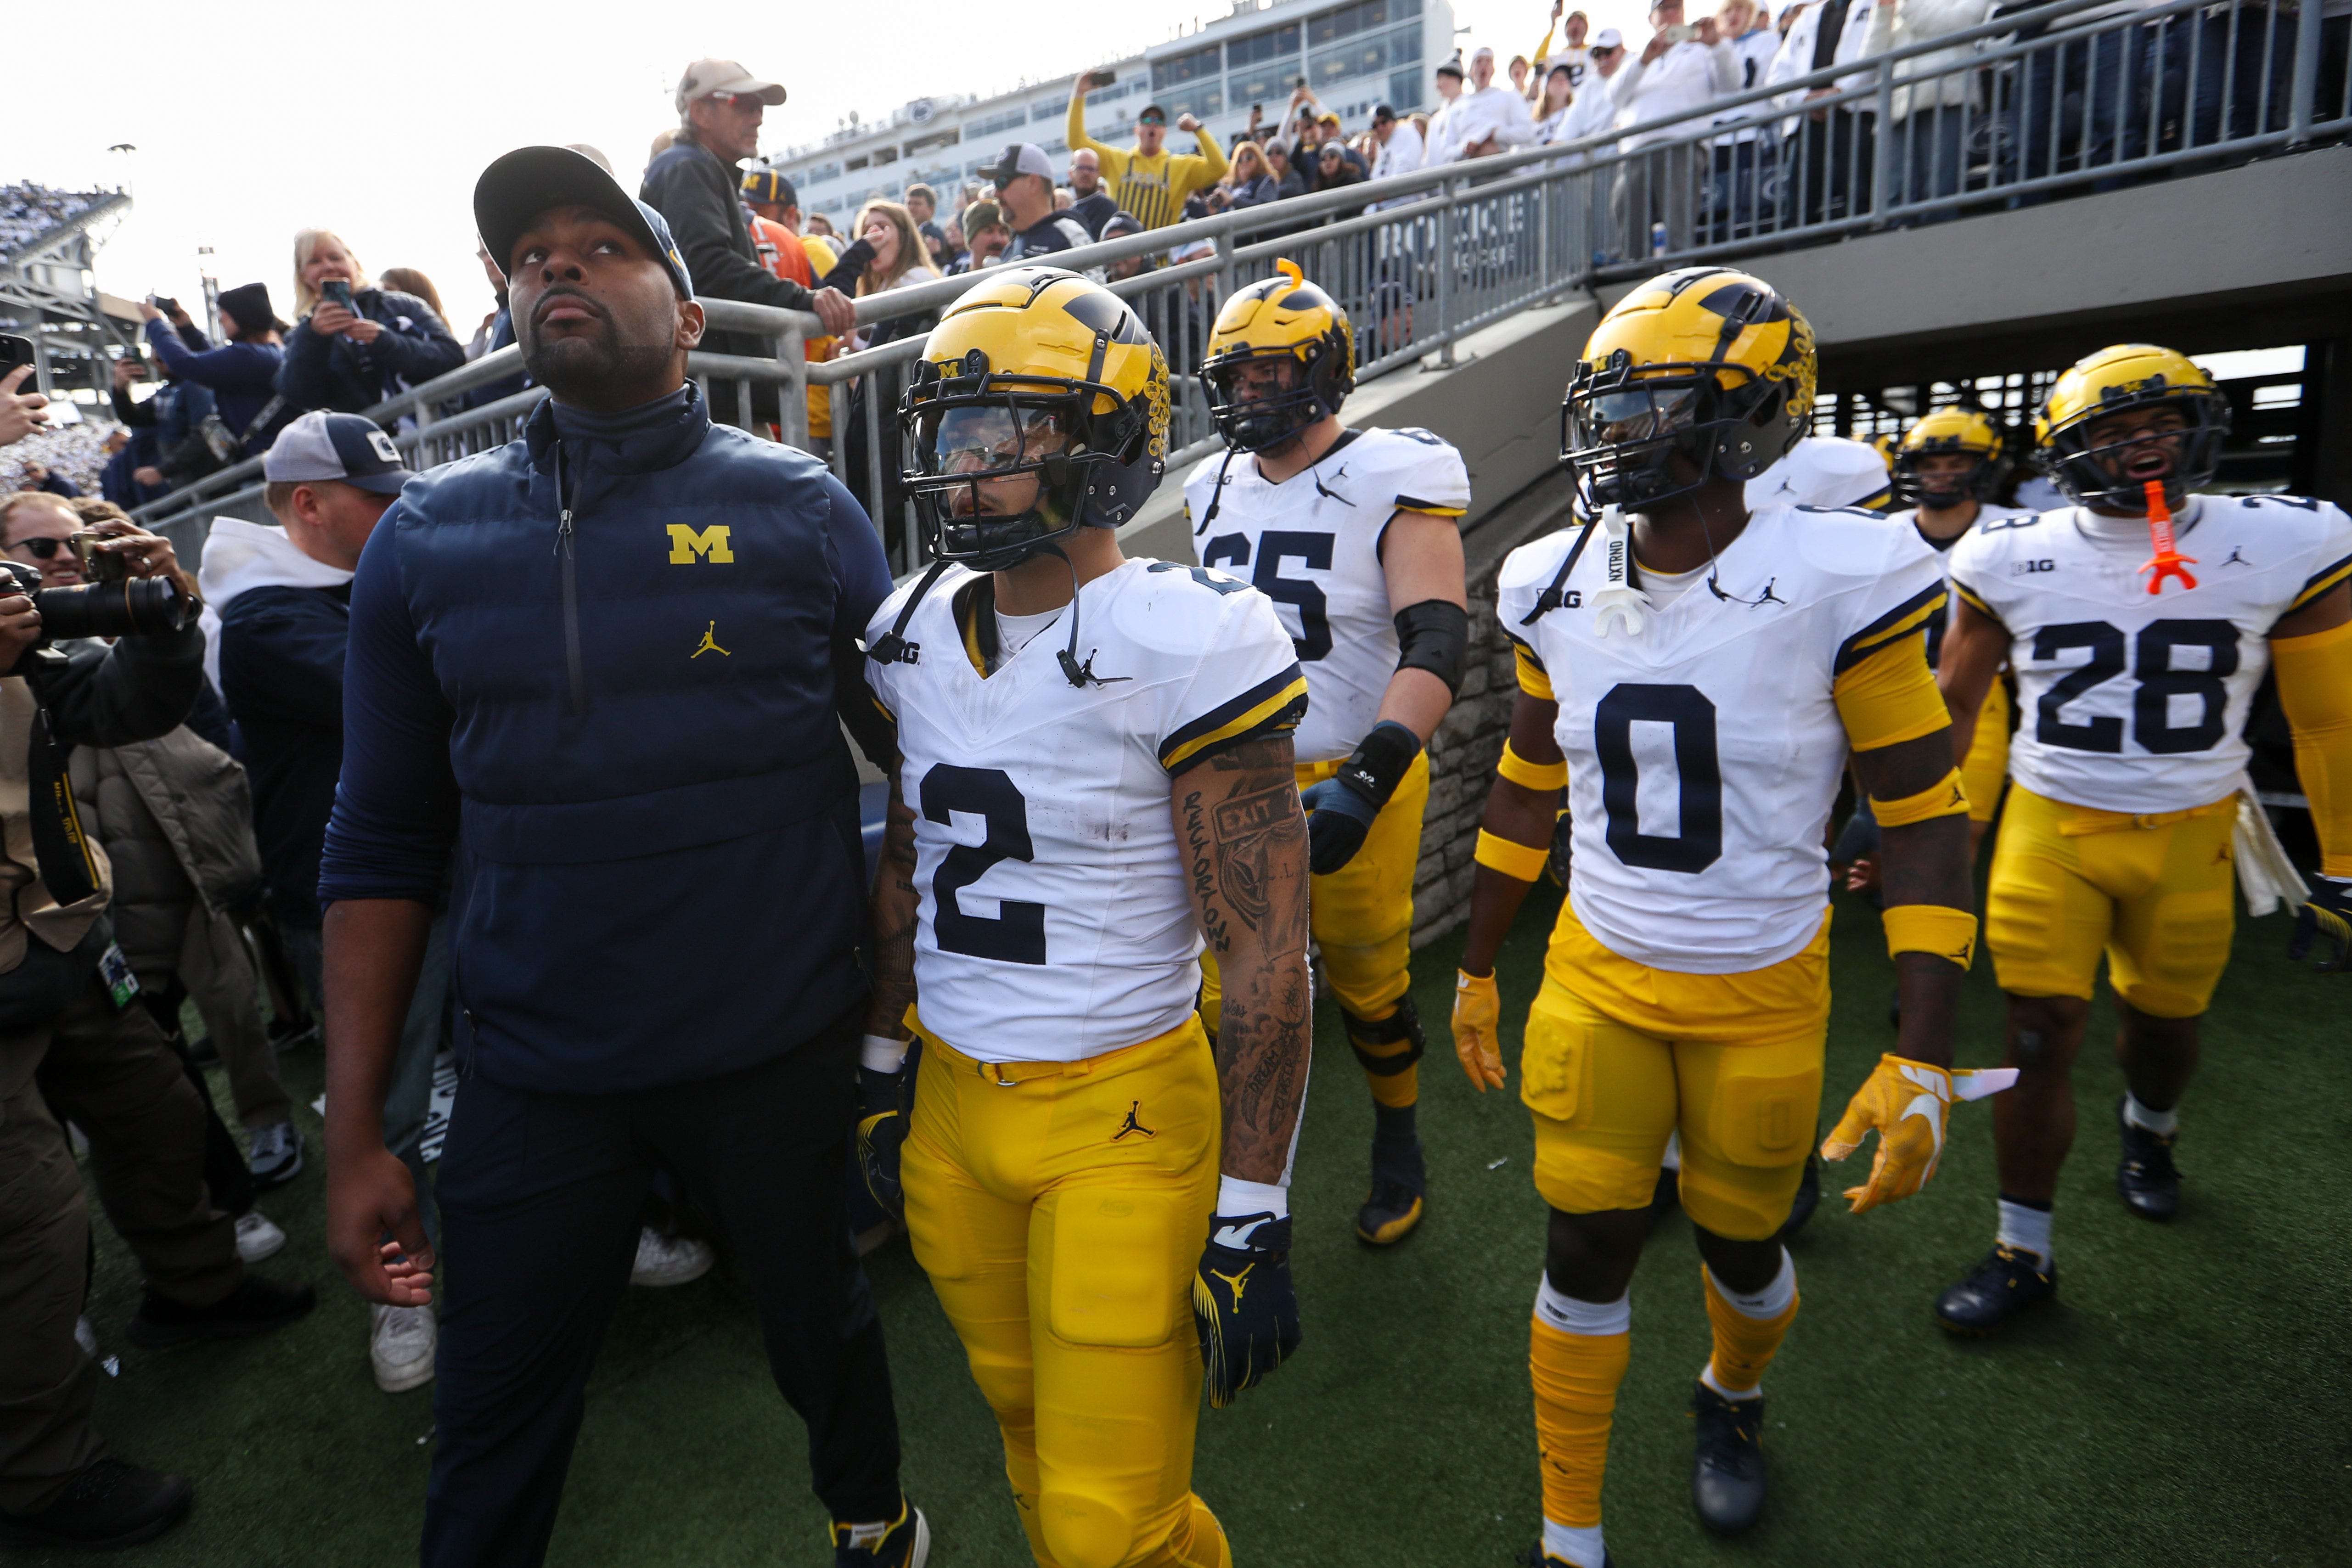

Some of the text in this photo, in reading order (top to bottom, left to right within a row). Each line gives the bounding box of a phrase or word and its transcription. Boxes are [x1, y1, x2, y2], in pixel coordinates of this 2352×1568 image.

[938, 361, 959, 379] M
[1592, 356, 1608, 373] M
[665, 523, 734, 565] M
[1609, 540, 1624, 582] NXTRND
[2033, 618, 2242, 754] 28
[1595, 683, 1723, 874] 0
[1221, 798, 1271, 830] EXIT
[920, 762, 1046, 965] 2
[1183, 791, 1231, 952] RECTORTOWN
